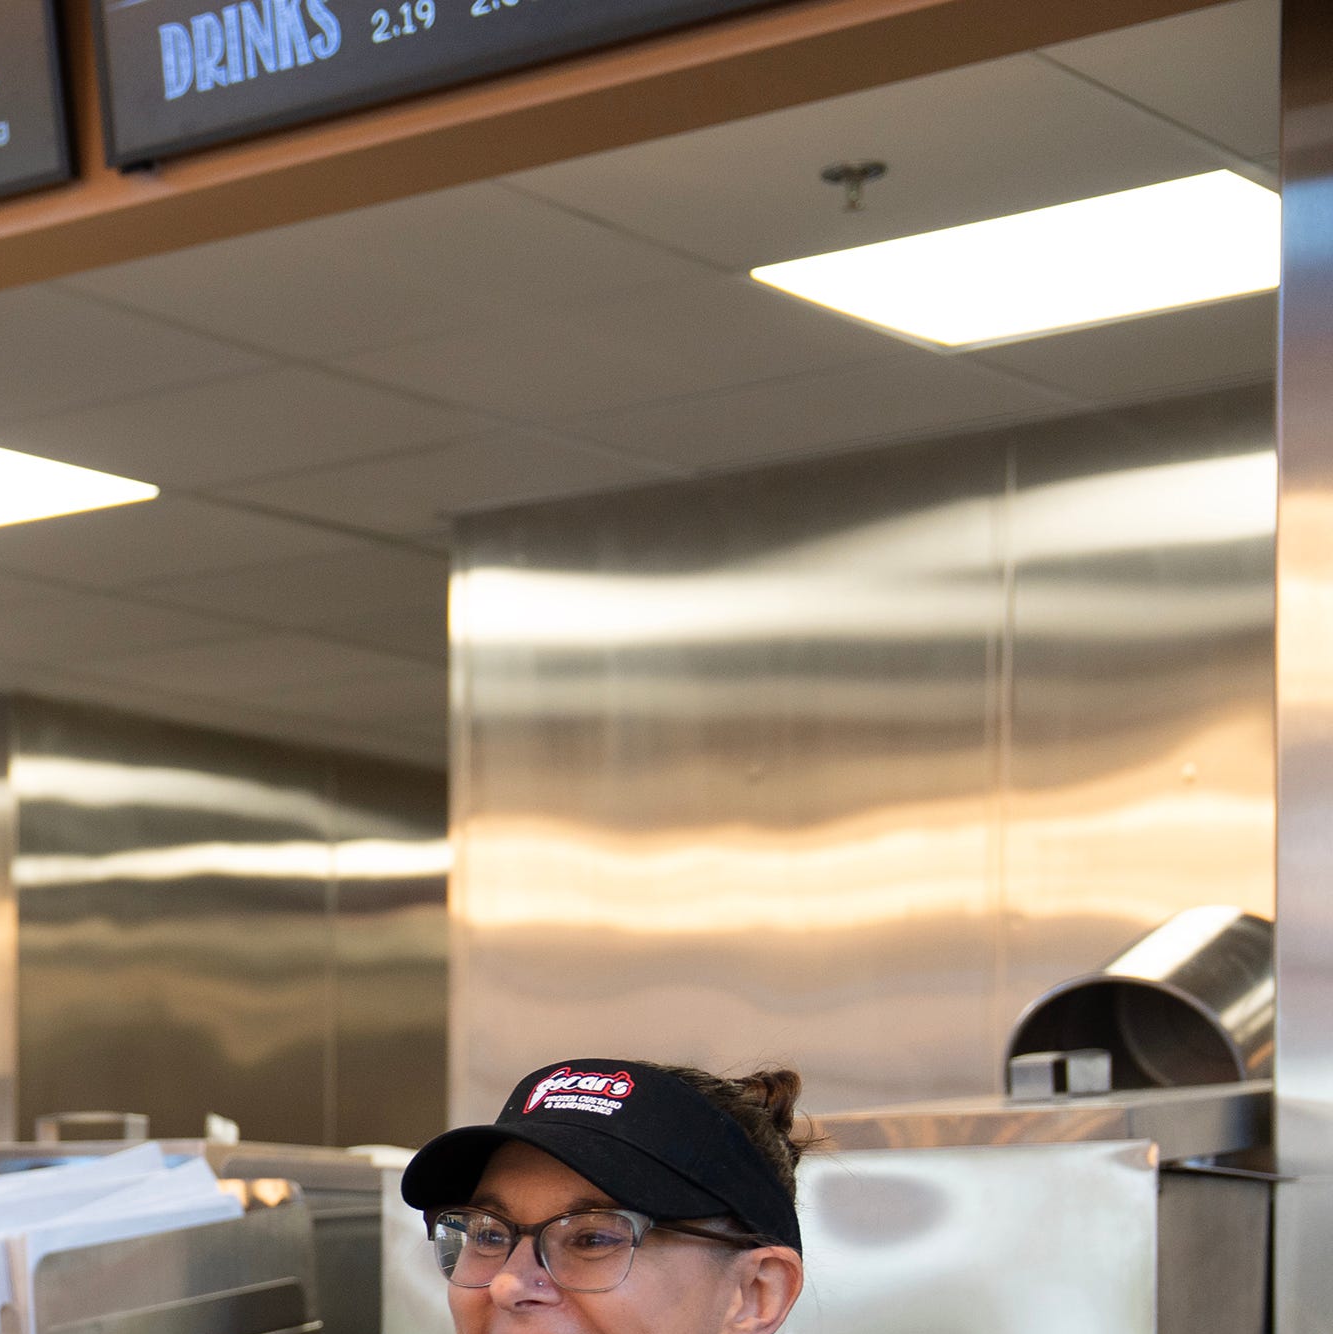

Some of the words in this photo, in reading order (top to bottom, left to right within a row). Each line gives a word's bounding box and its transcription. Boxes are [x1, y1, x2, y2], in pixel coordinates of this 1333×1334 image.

[159, 0, 344, 100] DRINKS
[370, 0, 436, 44] 2.19
[578, 1094, 623, 1111] CUSTARD
